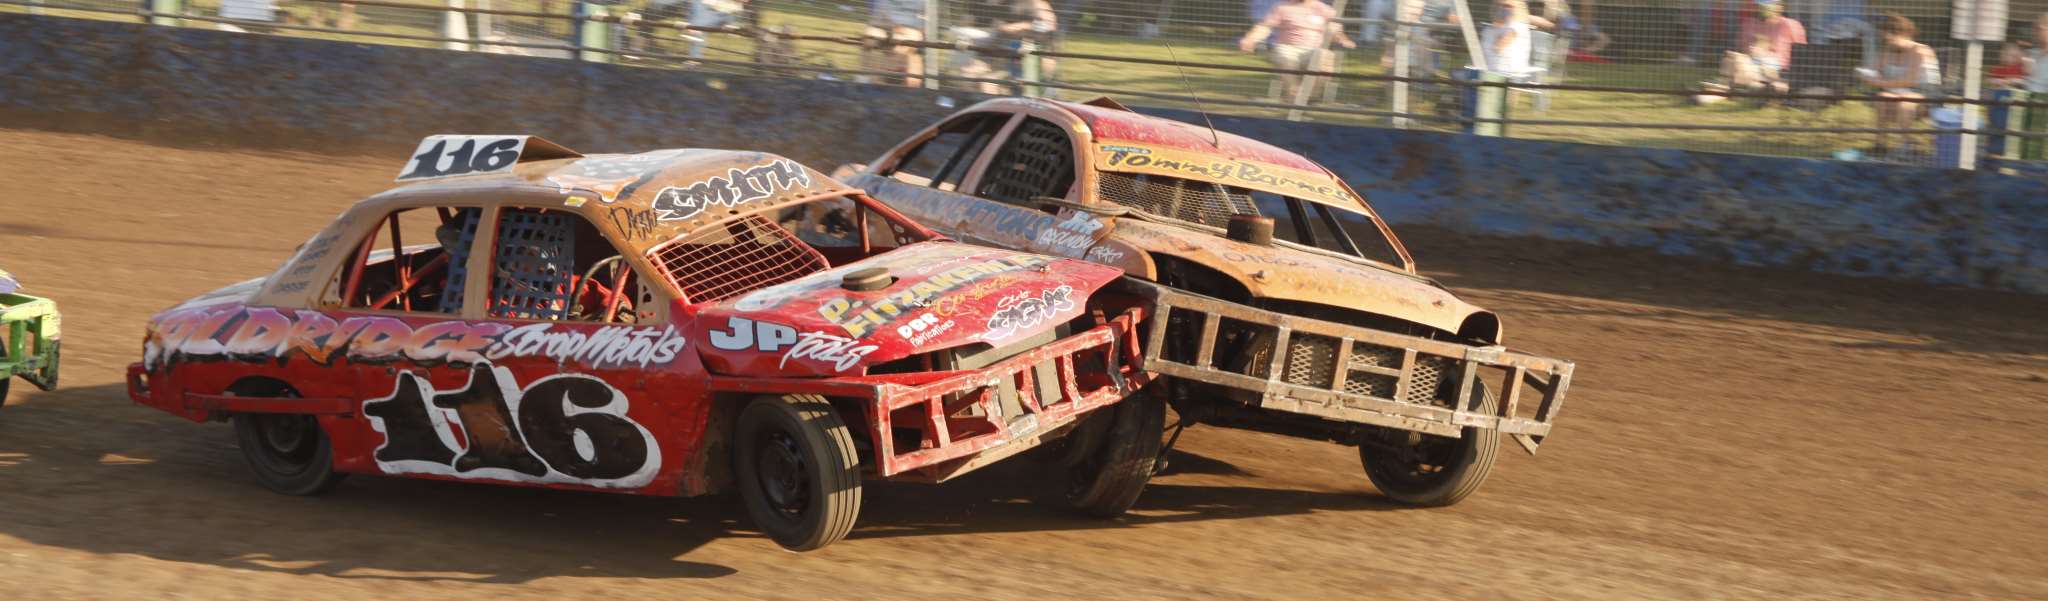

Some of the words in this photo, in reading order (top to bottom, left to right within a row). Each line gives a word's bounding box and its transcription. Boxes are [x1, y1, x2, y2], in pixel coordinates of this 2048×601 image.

[398, 138, 520, 180] 116
[651, 159, 810, 222] SMITH
[709, 316, 798, 352] JP
[897, 312, 940, 340] DBR
[362, 358, 662, 489] 116
